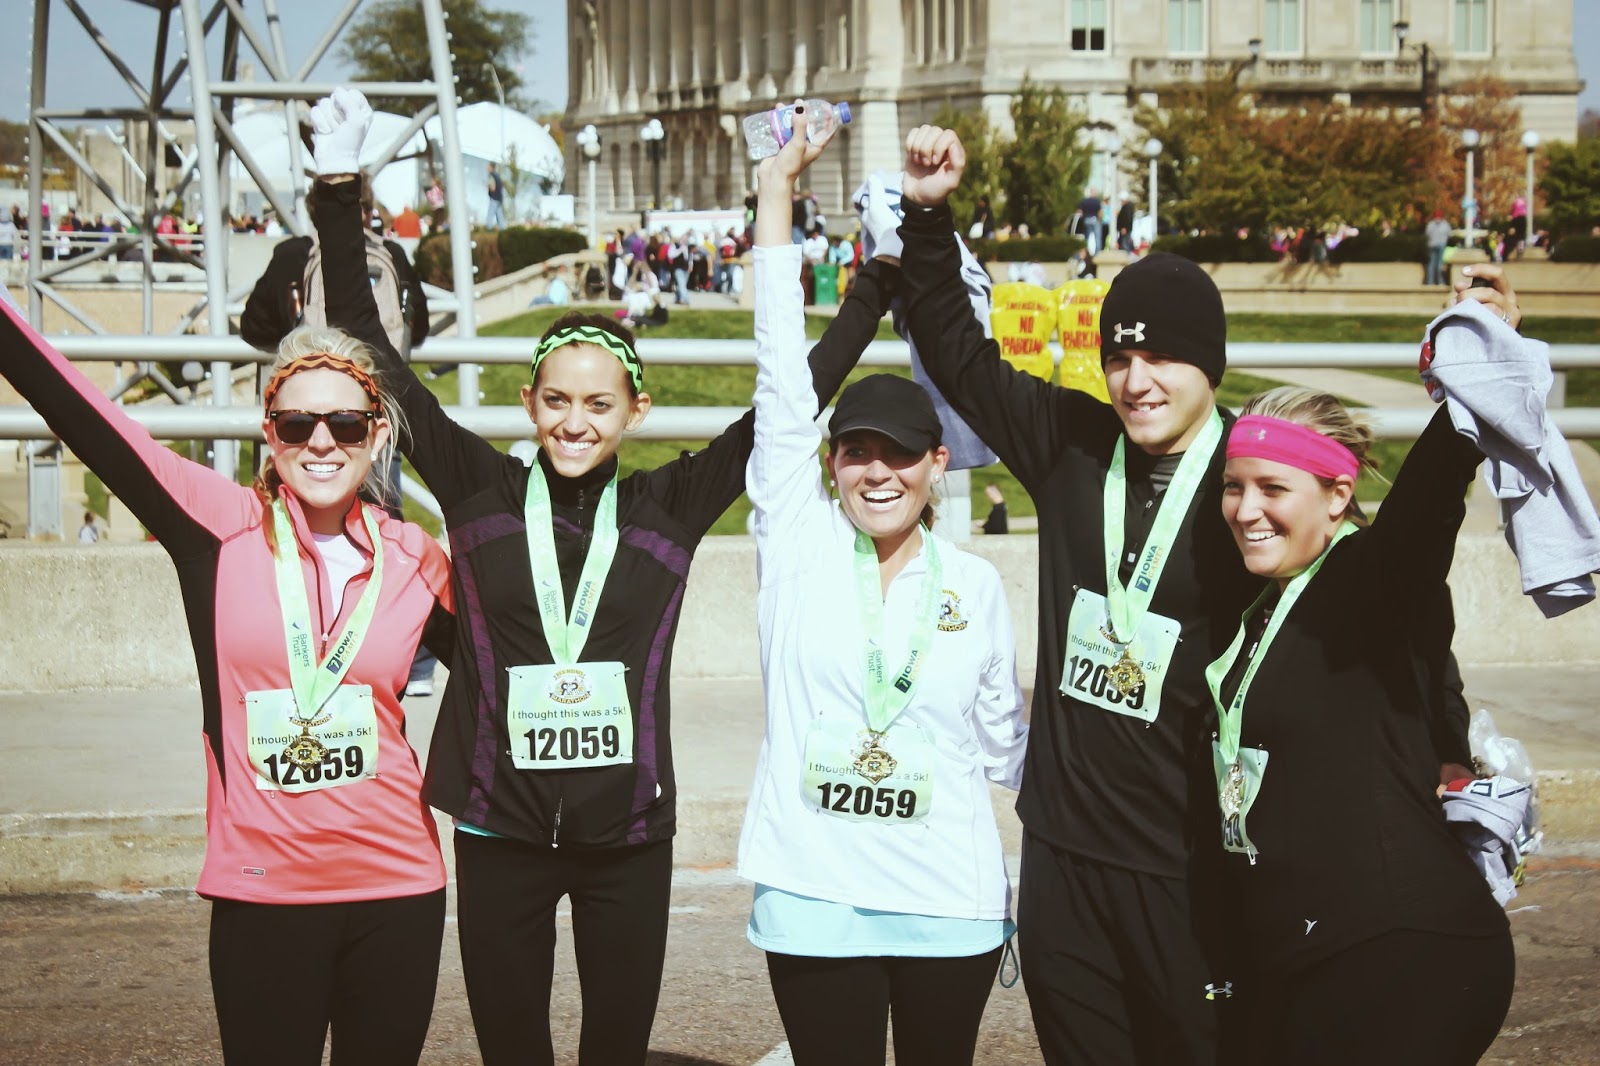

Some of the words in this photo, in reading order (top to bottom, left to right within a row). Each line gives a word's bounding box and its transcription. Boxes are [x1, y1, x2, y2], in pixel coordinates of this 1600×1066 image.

[1020, 315, 1034, 333] NO
[1078, 310, 1093, 327] NO
[1002, 337, 1043, 355] PARKIN
[1063, 331, 1102, 350] PARKIN
[1141, 545, 1158, 575] IOWA
[578, 580, 592, 611] IOWA
[300, 633, 310, 668] Bankers
[335, 630, 354, 658] IOWA
[1071, 634, 1101, 651] thought
[1102, 646, 1118, 658] this
[1146, 661, 1161, 673] 5k!
[876, 649, 884, 684] Bankers
[902, 649, 919, 678] IOWA
[552, 693, 589, 704] MARATHON
[512, 711, 516, 719] I
[518, 709, 557, 721] thought
[561, 708, 579, 718] this
[583, 709, 602, 717] was
[613, 706, 627, 716] 5k!
[323, 730, 345, 739] was
[356, 727, 372, 737] 5k!
[524, 725, 620, 761] 12059
[815, 763, 856, 776] thought
[904, 773, 910, 781] a
[913, 772, 929, 782] 5k!
[817, 781, 917, 819] 12059
